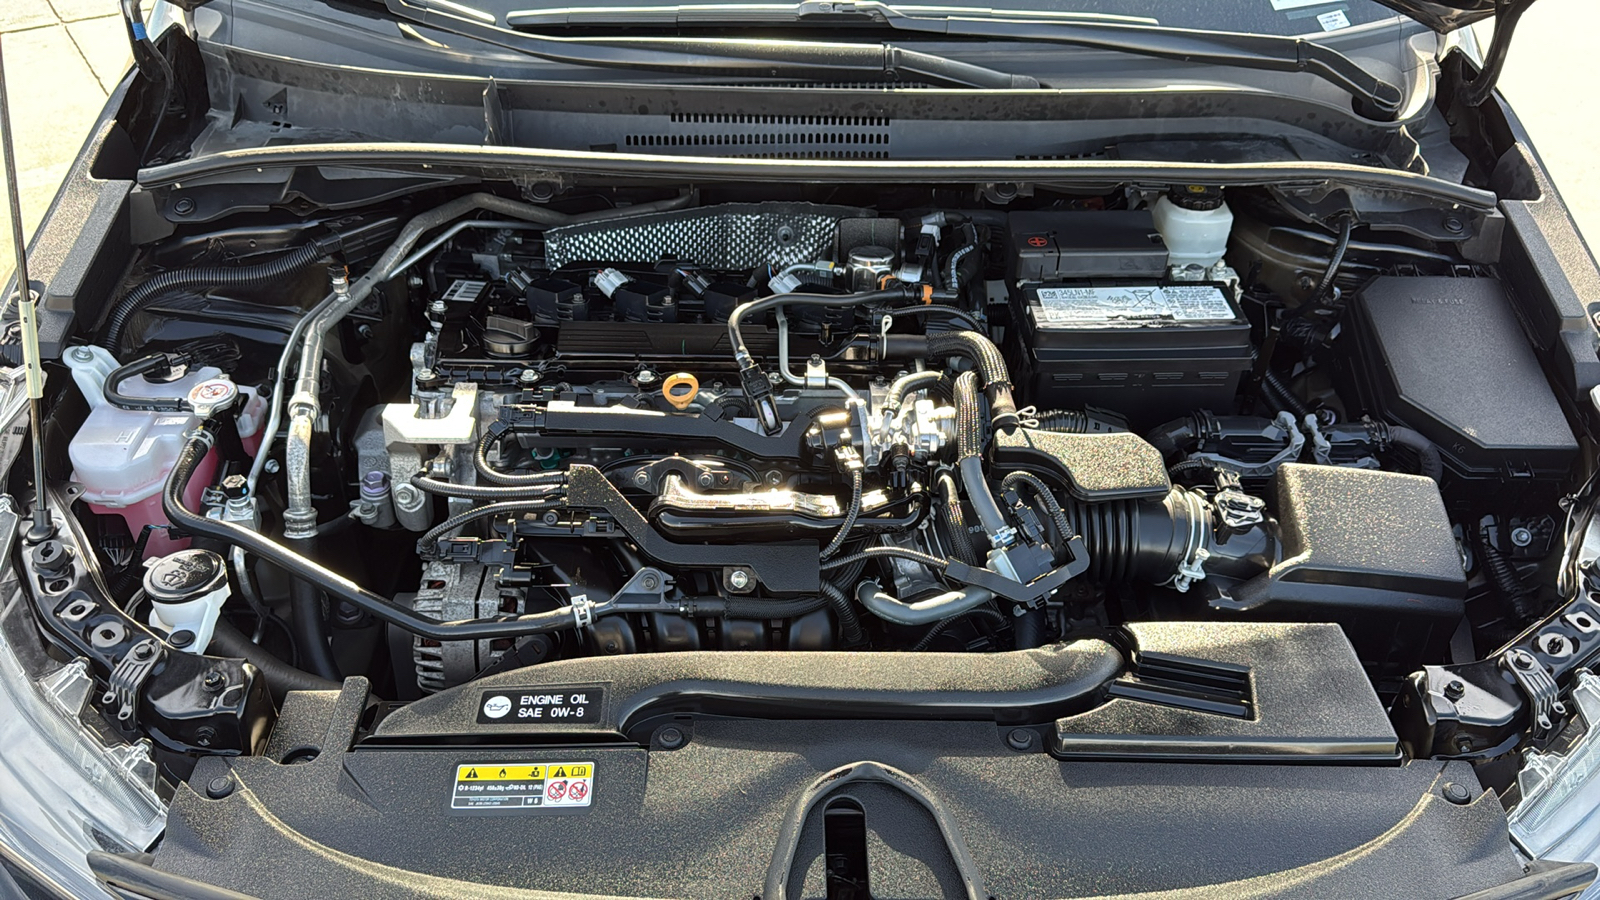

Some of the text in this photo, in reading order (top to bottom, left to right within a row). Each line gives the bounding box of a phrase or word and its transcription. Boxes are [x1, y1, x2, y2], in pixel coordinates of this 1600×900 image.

[520, 694, 589, 705] ENGINE OIL
[518, 707, 584, 718] SAE 0W-8
